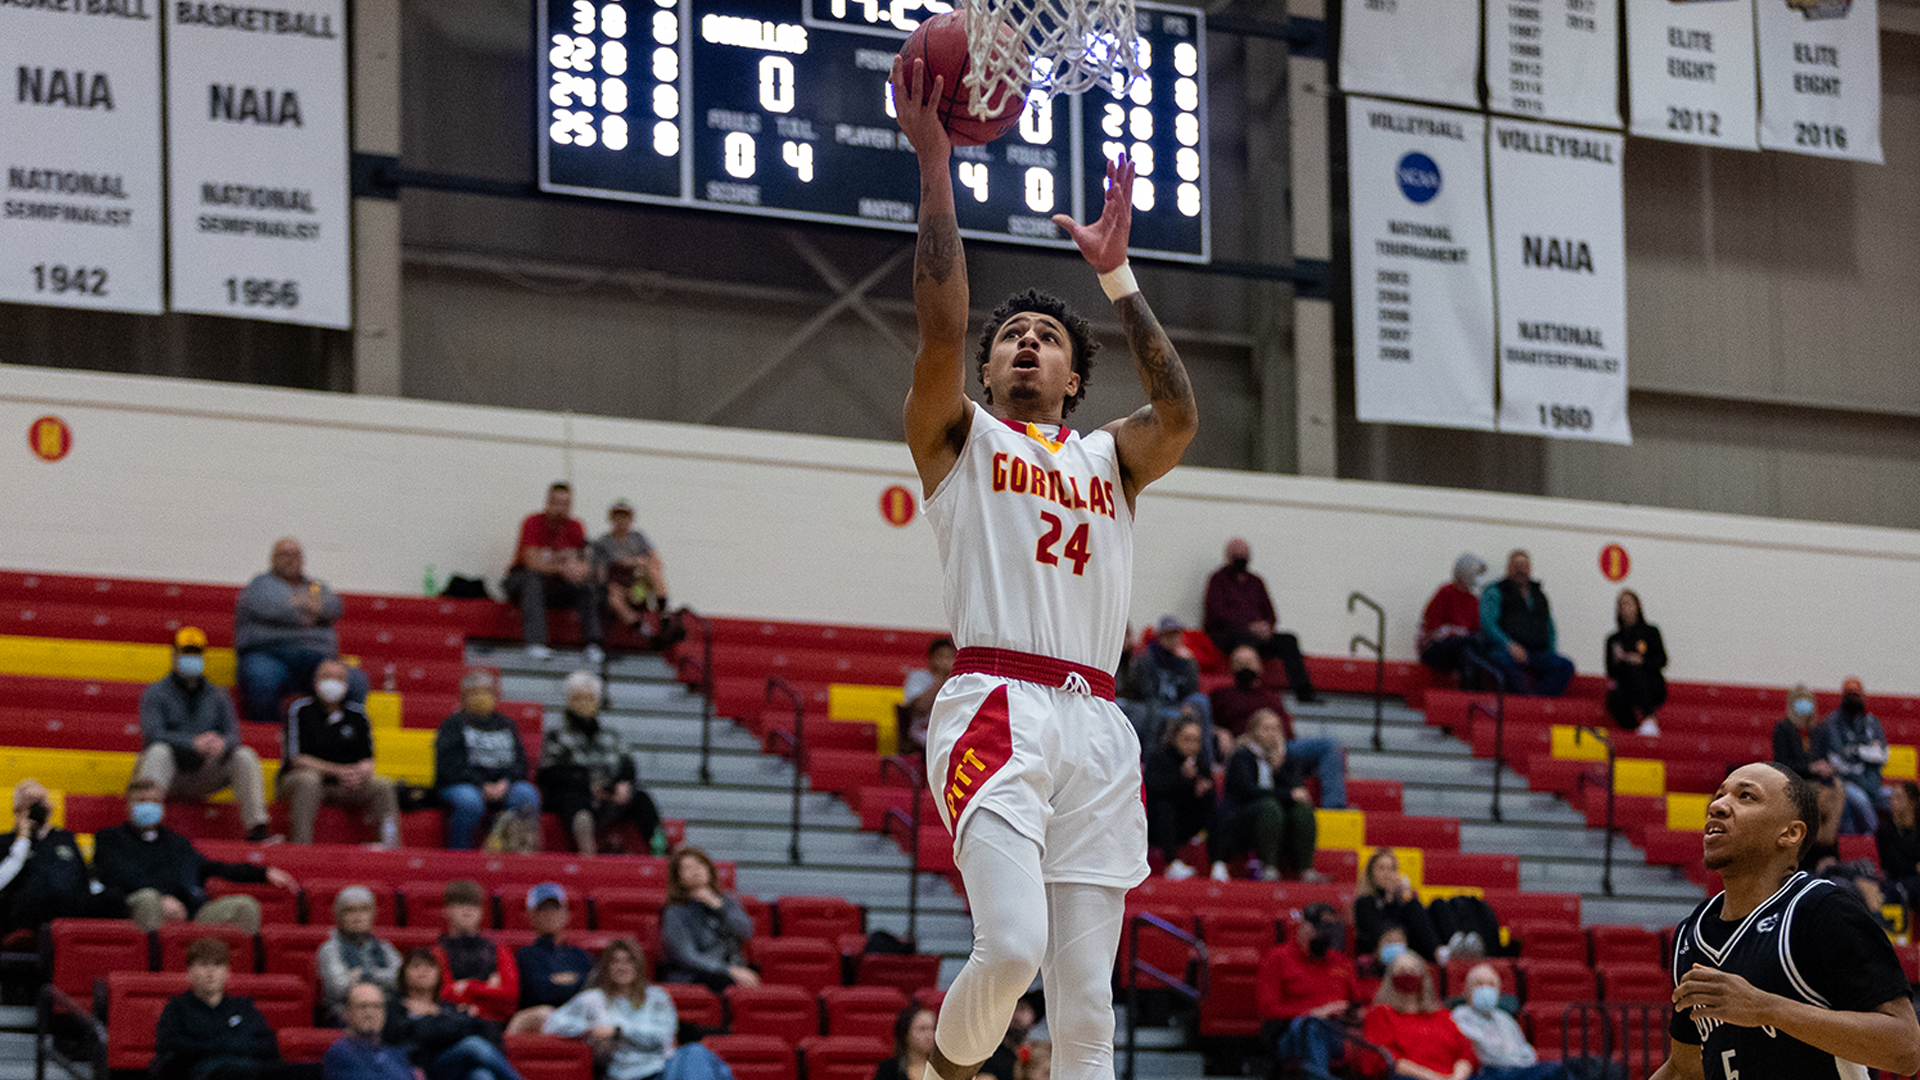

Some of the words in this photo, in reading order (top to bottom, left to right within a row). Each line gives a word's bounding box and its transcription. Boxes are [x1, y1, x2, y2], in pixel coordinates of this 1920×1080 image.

[176, 1, 337, 39] BASKETBALL
[549, 34, 596, 72] 22
[1667, 26, 1713, 52] ELITE
[1793, 42, 1840, 68] ELITE
[758, 56, 794, 113] 0
[1666, 57, 1716, 83] EIGHT
[1793, 73, 1841, 97] EIGHT
[17, 66, 115, 111] NAIA
[549, 71, 597, 107] 24
[209, 84, 305, 129] NAIA
[1667, 106, 1721, 136] 2012
[1368, 112, 1465, 141] VOLLEYBALL
[1794, 121, 1847, 149] 2016
[725, 132, 756, 179] 0
[782, 141, 813, 182] 4
[1498, 129, 1613, 165] VOLLEYBALL
[8, 168, 128, 200] NATIONAL
[202, 182, 318, 214] NATIONAL
[958, 161, 989, 202] 4
[1025, 167, 1054, 212] 0
[4, 200, 133, 229] SEMIFINALIST
[198, 214, 320, 242] SEMIFINALIST
[1388, 220, 1452, 242] NATIONAL
[1375, 240, 1468, 265] TOURNAMENT
[1522, 235, 1594, 274] NAIA
[32, 263, 108, 298] 1942
[225, 277, 301, 309] 1956
[1518, 320, 1604, 349] NATIONAL
[1538, 403, 1594, 431] 1980
[992, 451, 1116, 521] GORILLAS
[1035, 509, 1093, 577] 24
[946, 746, 987, 819] PITT
